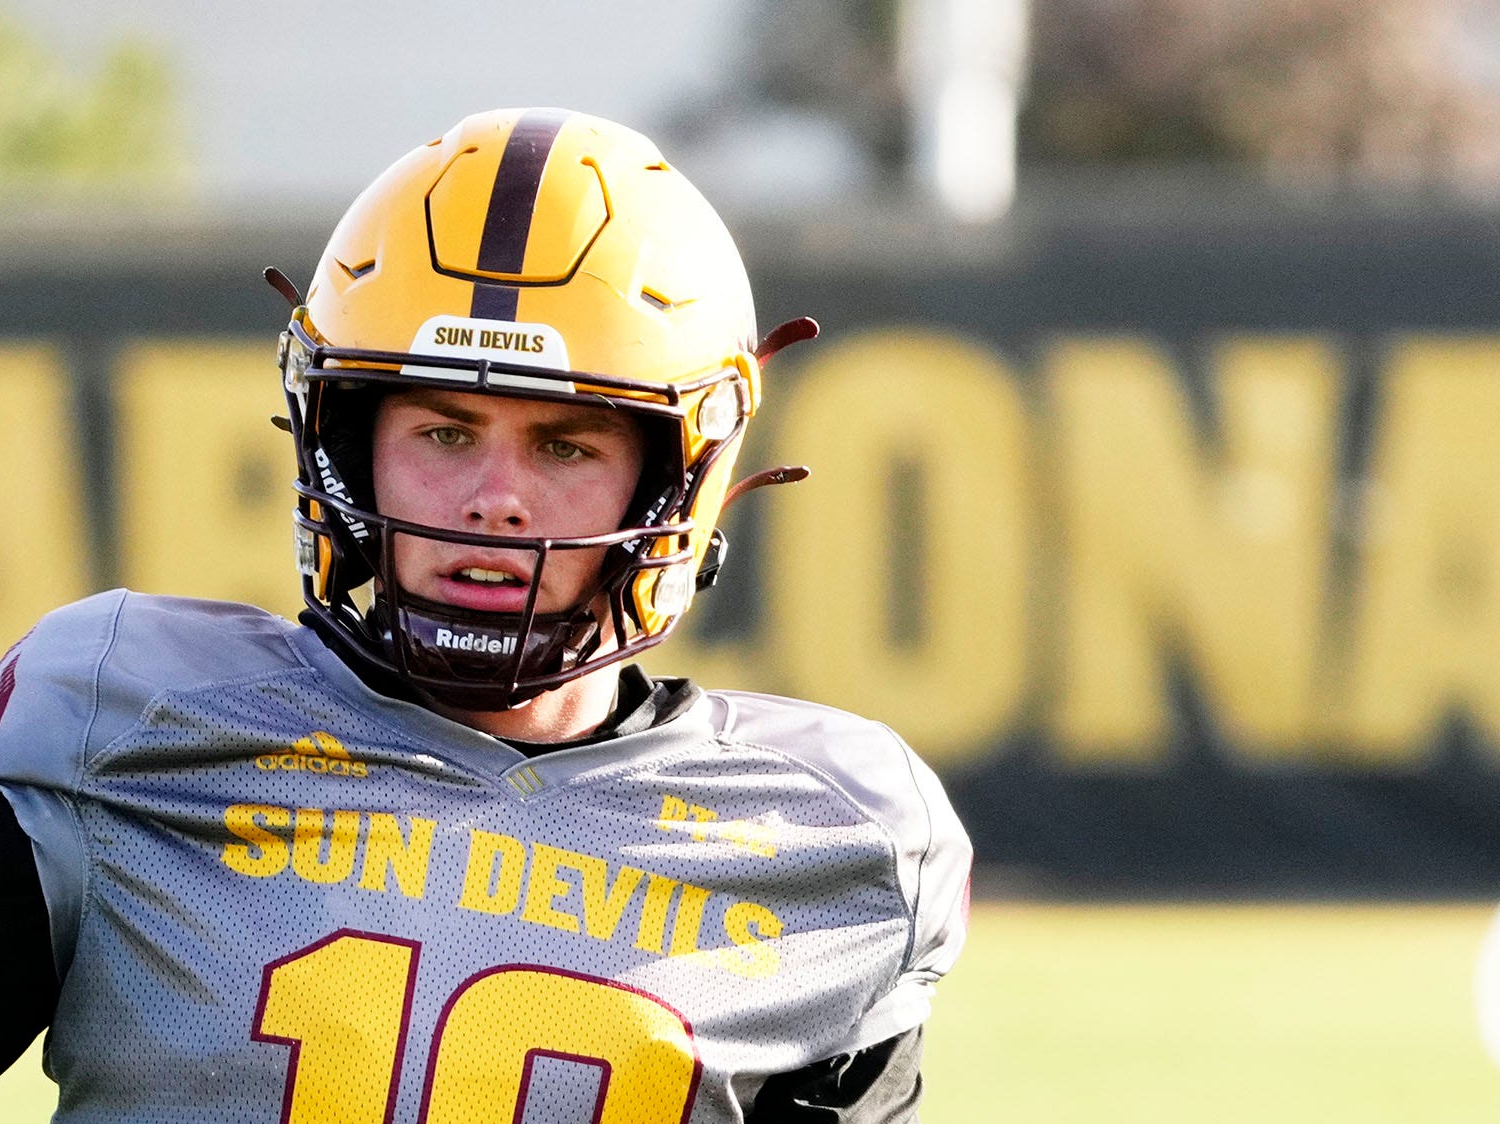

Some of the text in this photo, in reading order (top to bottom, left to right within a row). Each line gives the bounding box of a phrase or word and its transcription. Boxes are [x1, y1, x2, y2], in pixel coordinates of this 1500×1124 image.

[434, 326, 545, 353] SUN DEVILS
[436, 627, 518, 655] Riddell
[255, 750, 368, 778] adidas
[220, 803, 785, 978] SUN DEVILS
